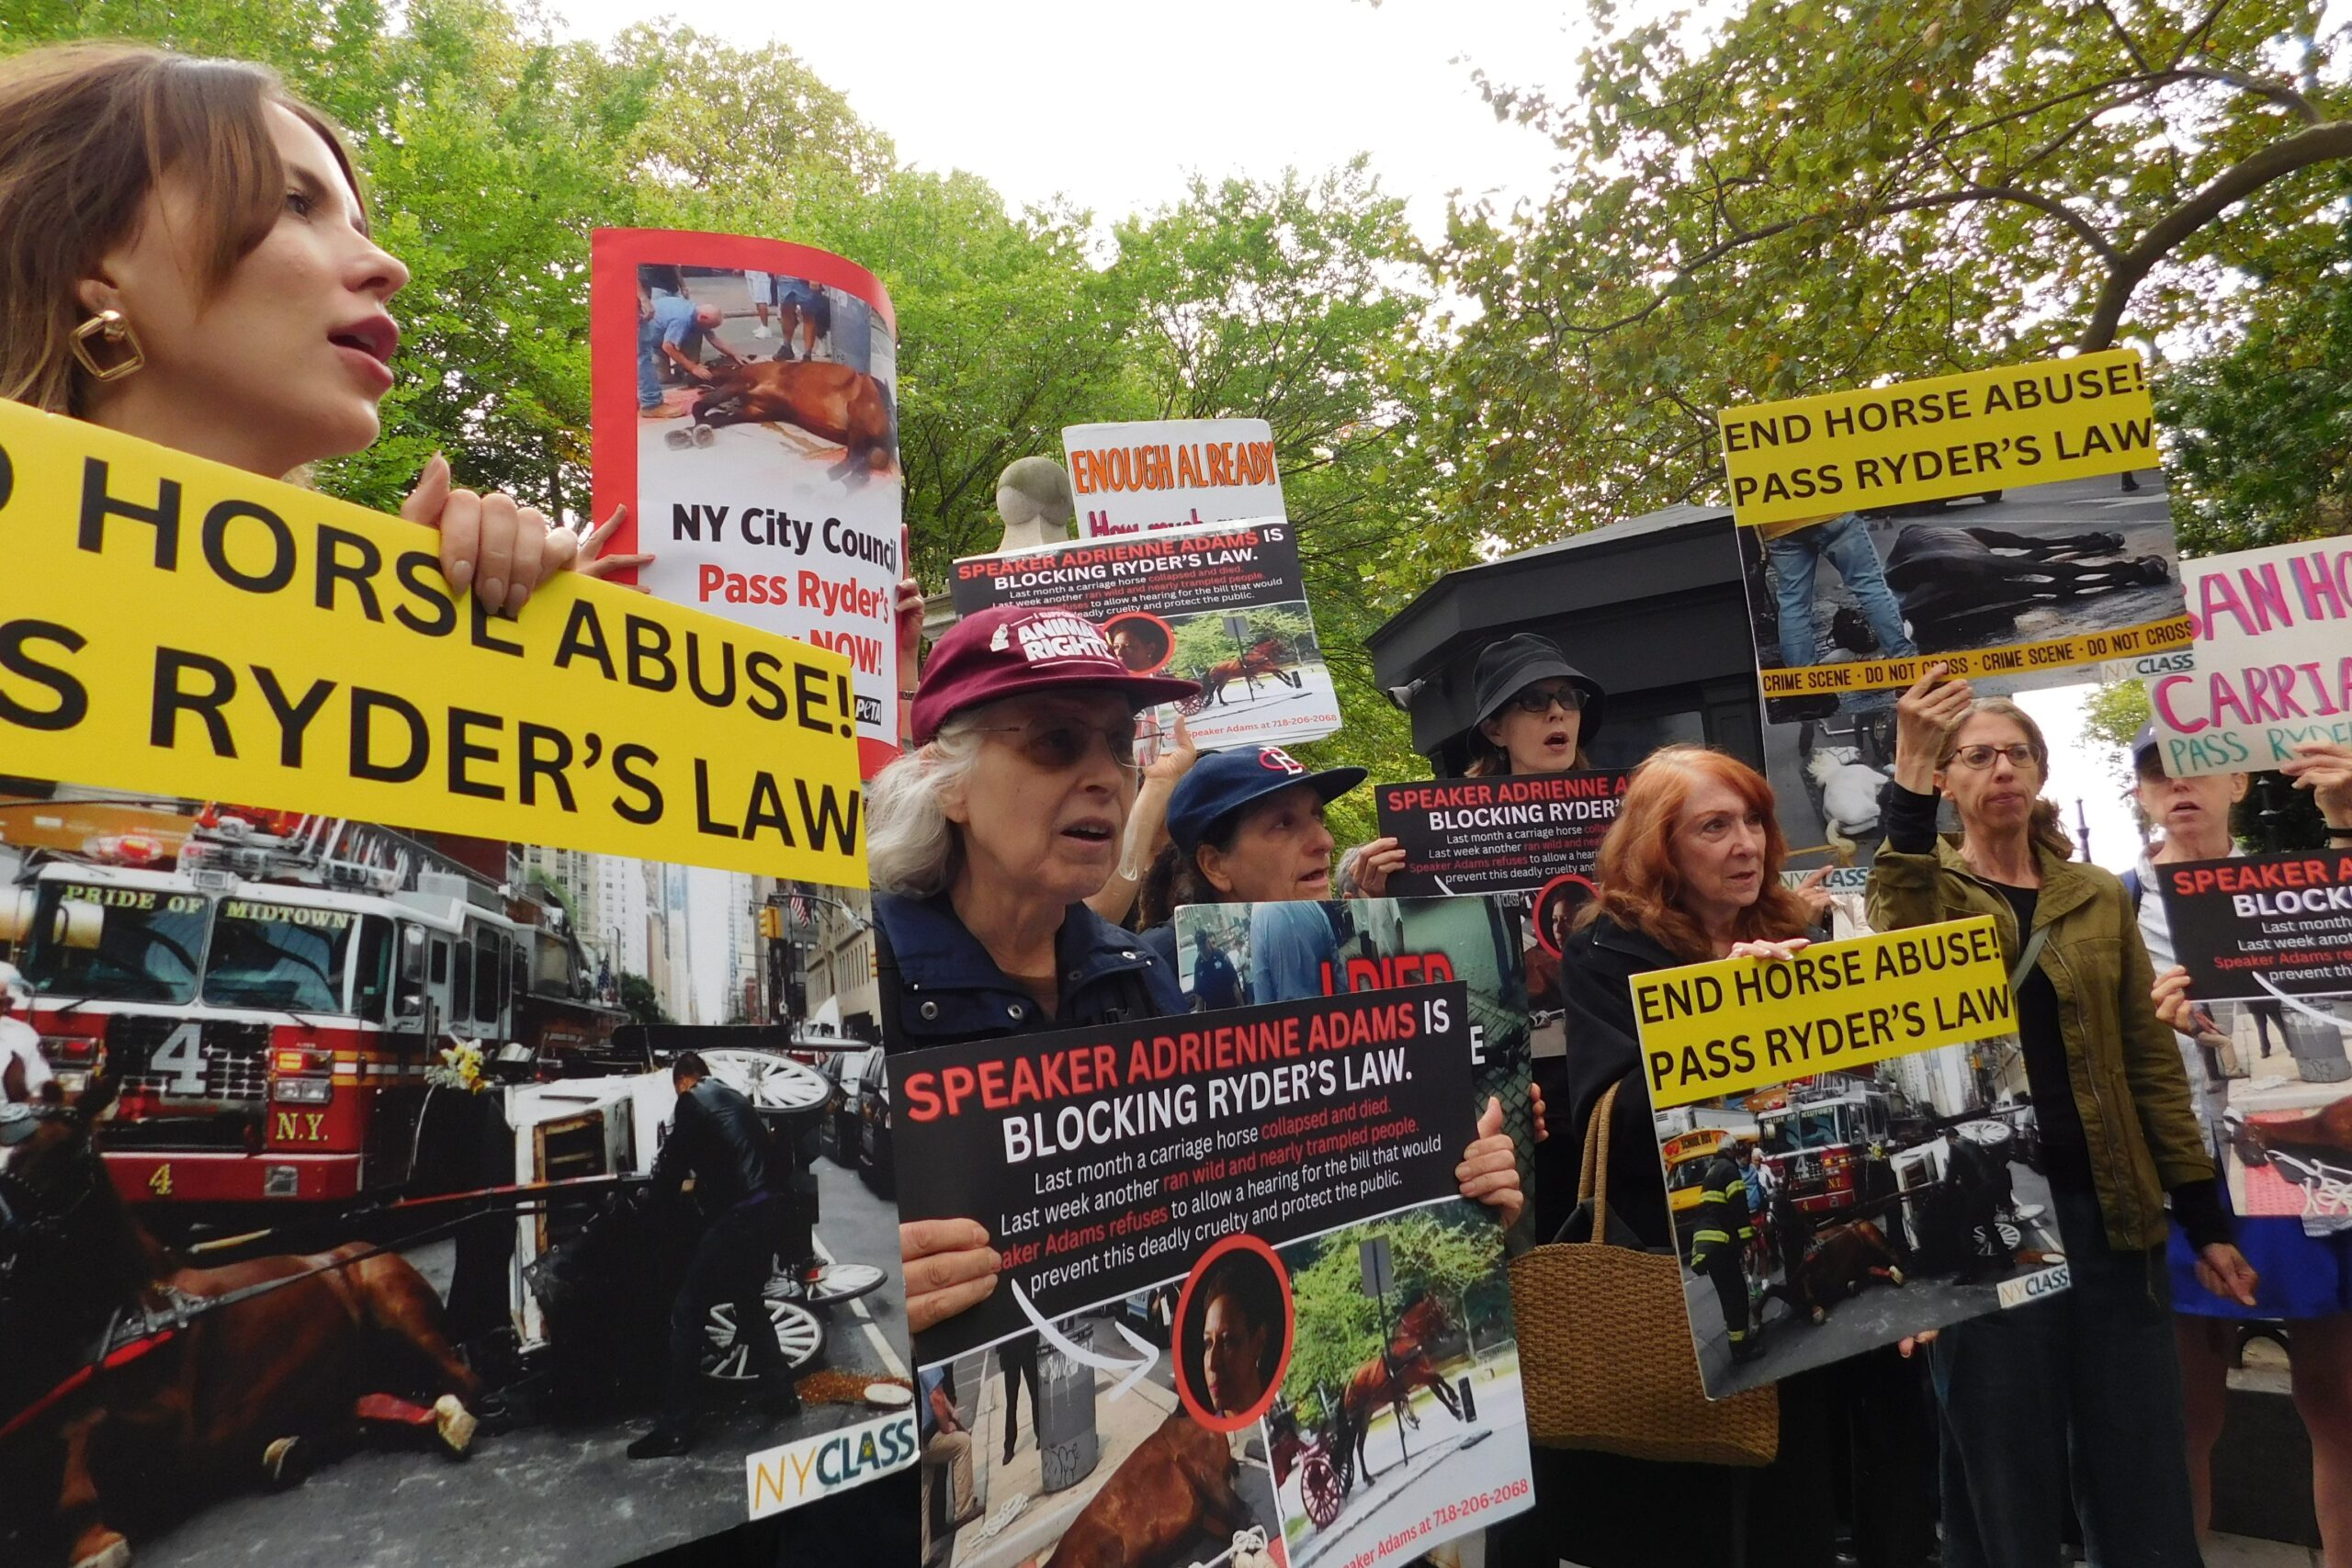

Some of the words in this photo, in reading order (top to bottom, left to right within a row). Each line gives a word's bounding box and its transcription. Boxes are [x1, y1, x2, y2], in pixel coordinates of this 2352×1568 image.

[1724, 412, 1810, 453] END
[1824, 389, 1973, 439] HORSE
[1984, 361, 2146, 415] ABUSE!
[1071, 445, 1174, 494] ENOUGH
[1179, 441, 1275, 489] ALREADY
[1733, 463, 1843, 507] PASS
[1854, 434, 2041, 491] RYDER'S
[2053, 417, 2153, 461] LAW
[673, 503, 729, 542] NY
[741, 508, 812, 555] City
[822, 517, 897, 575] Council
[958, 555, 1056, 580] SPEAKER
[1062, 542, 1174, 567] ADRIENNE
[1181, 532, 1259, 553] ADAMS
[1263, 528, 1284, 542] IS
[699, 564, 787, 605] Pass
[994, 565, 1106, 590] BLOCKING
[1112, 553, 1202, 576] RYDER'S
[1206, 548, 1259, 566] LAW.
[1010, 591, 1031, 599] Last
[1033, 586, 1066, 595] month
[1076, 581, 1116, 592] carriage
[1118, 577, 1147, 585] horse
[1148, 570, 1195, 583] collapsed
[1198, 568, 1216, 576] and
[1015, 597, 1042, 607] week
[1043, 593, 1082, 604] another
[1181, 576, 1227, 590] trampled
[1103, 597, 1129, 605] allow
[1139, 591, 1176, 602] hearing
[1178, 589, 1193, 597] for
[1194, 586, 1211, 594] the
[1213, 583, 1228, 592] bill
[1230, 581, 1251, 591] that
[1253, 578, 1283, 589] would
[1106, 603, 1140, 615] cruelty
[1143, 602, 1161, 610] and
[1164, 597, 1201, 609] protect
[1203, 594, 1219, 604] the
[1222, 592, 1255, 603] public.
[2183, 562, 2293, 641] AN
[554, 601, 852, 739] ABUSE!
[1763, 673, 1803, 692] CRIME
[1808, 669, 1851, 688] SCENE
[1865, 666, 1883, 683] DO
[1889, 662, 1916, 681] NOT
[1983, 650, 2023, 671] CRIME
[2028, 643, 2075, 664] SCENE
[2087, 638, 2107, 656] DO
[2111, 631, 2140, 653] NOT
[2146, 620, 2193, 644] CROSS
[1227, 724, 1259, 733] Adams
[1272, 714, 1338, 728] 718-206-2068
[150, 646, 664, 825] RYDER'S
[694, 758, 860, 856] LAW
[2169, 732, 2248, 774] PASS
[1388, 784, 1493, 811] SPEAKER
[1498, 777, 1610, 803] ADRIENNE
[1429, 804, 1544, 830] BLOCKING
[1549, 798, 1625, 821] RYDER'
[1429, 849, 1451, 859] Last
[1453, 845, 1480, 857] week
[1482, 842, 1521, 854] another
[1447, 834, 1469, 844] Last
[1471, 830, 1504, 842] month
[1515, 827, 1554, 840] carriage
[1555, 826, 1582, 836] horse
[1409, 861, 1451, 875] Speaker
[1453, 857, 1489, 869] Adams
[1492, 855, 1528, 867] refuses
[1543, 852, 1566, 863] allow
[1445, 870, 1487, 885] prevent
[1489, 869, 1509, 879] this
[1510, 866, 1543, 878] deadly
[1544, 863, 1577, 874] cruelty
[2174, 860, 2329, 896] SPEAKER
[64, 885, 155, 909] PRIDE
[168, 896, 204, 915] OF
[2232, 886, 2352, 918] BLOCK
[2237, 938, 2270, 951] Last
[2274, 934, 2315, 949] week
[2261, 920, 2295, 934] Last
[2299, 916, 2351, 931] month
[1637, 976, 1722, 1024] END
[1734, 950, 1865, 1006] HORSE
[1874, 926, 2000, 981] ABUSE!
[2214, 954, 2274, 970] Speaker
[2279, 949, 2333, 964] Adams
[2269, 966, 2331, 983] prevent
[1648, 1035, 1755, 1091] PASS
[1765, 1001, 1925, 1066] RYDER'S
[1934, 985, 2010, 1032] LAW
[151, 1022, 209, 1098] 4
[903, 1044, 1119, 1123] SPEAKER
[1127, 1017, 1301, 1084] ADRIENNE
[1307, 1002, 1416, 1054] ADAMS
[1424, 998, 1450, 1034] IS
[1002, 1083, 1197, 1163] BLOCKING
[1208, 1059, 1337, 1119] RYDER'S
[1344, 1047, 1412, 1091] LAW.
[276, 1112, 328, 1141] N.Y.
[1035, 1167, 1072, 1194] Last
[1078, 1151, 1132, 1184] month
[1137, 1153, 1146, 1169] a
[1149, 1136, 1213, 1166] carriage
[1217, 1127, 1259, 1150] horse
[1261, 1109, 1328, 1140] collapsed
[1331, 1107, 1356, 1124] and
[1360, 1096, 1392, 1118] died.
[149, 1163, 173, 1194] 4
[1001, 1207, 1039, 1236] Last
[1045, 1192, 1090, 1224] week
[1094, 1178, 1159, 1211] another
[1163, 1171, 1188, 1192] ran
[1193, 1158, 1225, 1184] wild
[1229, 1151, 1256, 1177] and
[1261, 1140, 1302, 1168] nearly
[1306, 1124, 1367, 1156] trampled
[1371, 1116, 1419, 1143] people.
[1794, 1155, 1809, 1179] 4
[1046, 1223, 1105, 1257] Adams
[1109, 1206, 1168, 1237] refuses
[1170, 1201, 1187, 1219] to
[1192, 1189, 1232, 1213] allow
[1236, 1186, 1244, 1202] a
[1248, 1169, 1299, 1199] hearing
[1302, 1164, 1321, 1184] for
[1325, 1158, 1347, 1179] the
[1350, 1150, 1370, 1172] bill
[1373, 1145, 1399, 1166] that
[1402, 1134, 1442, 1158] would
[1031, 1254, 1099, 1299] prevent
[1103, 1243, 1135, 1269] this
[1138, 1226, 1190, 1259] deadly
[1195, 1211, 1248, 1241] cruelty
[1252, 1200, 1277, 1225] and
[1282, 1187, 1332, 1222] protect
[1335, 1180, 1357, 1201] the
[1361, 1168, 1402, 1199] public.
[754, 1418, 915, 1510] NYCLASS
[1378, 1527, 1418, 1559] Adams
[1419, 1517, 1431, 1535] at
[1432, 1478, 1528, 1529] 718-206-2068
